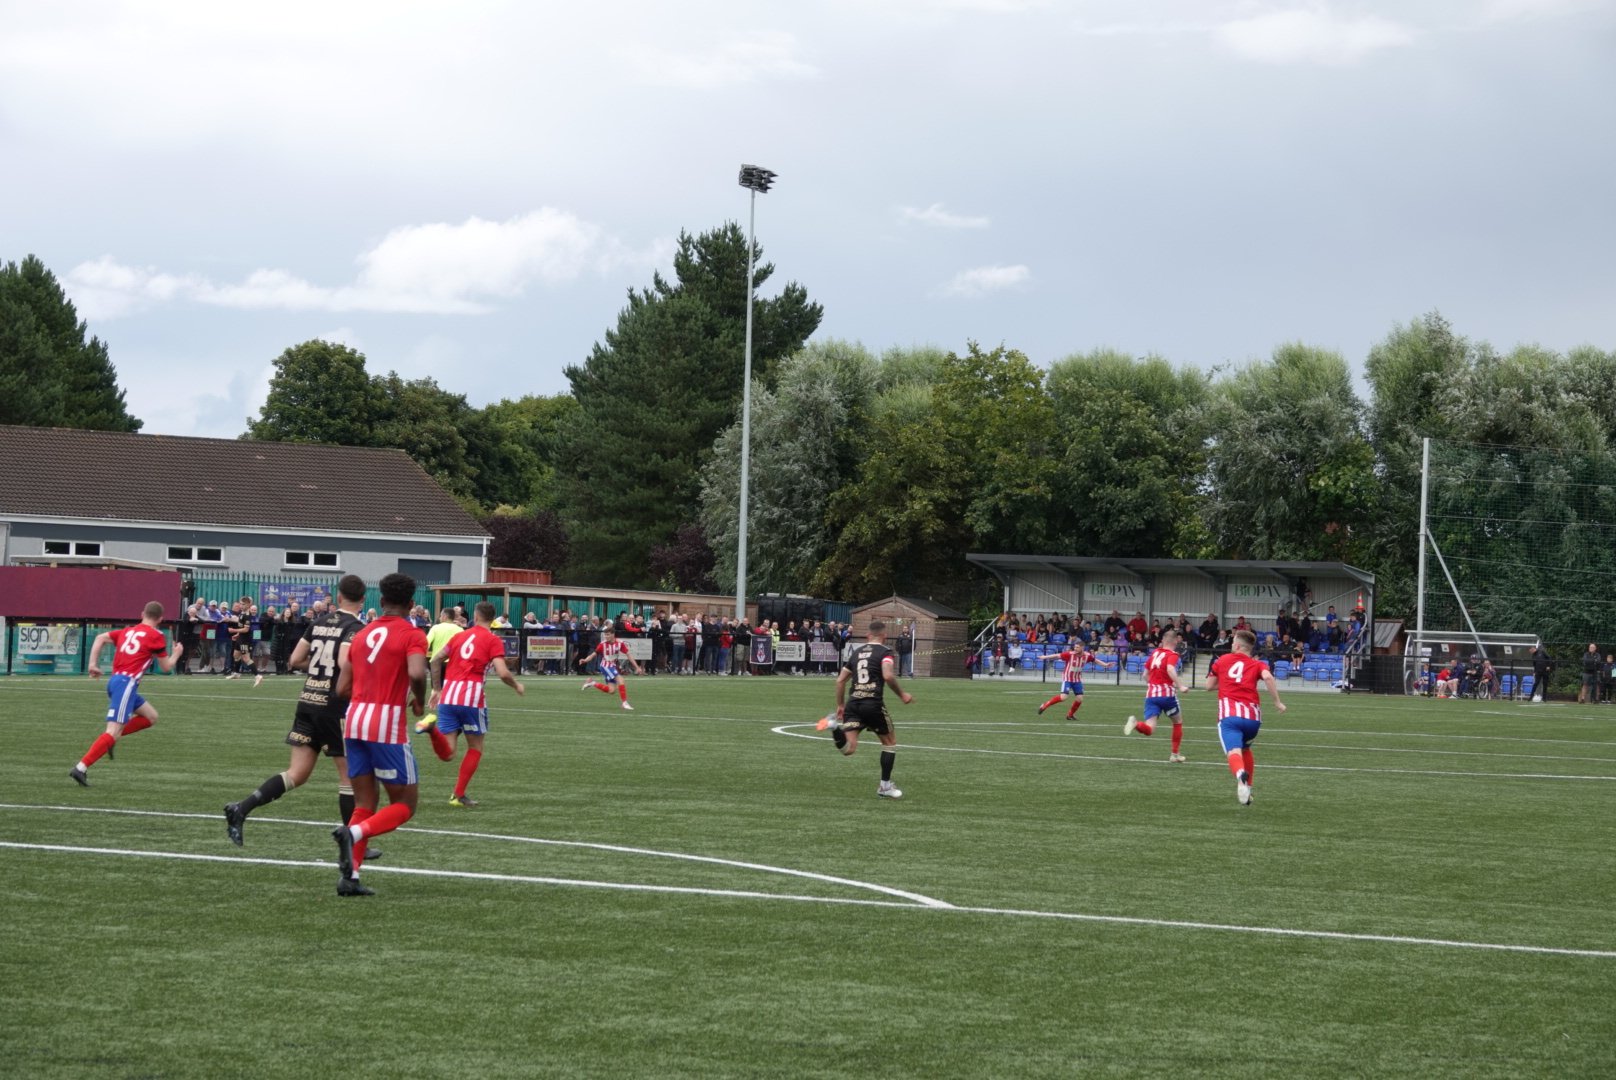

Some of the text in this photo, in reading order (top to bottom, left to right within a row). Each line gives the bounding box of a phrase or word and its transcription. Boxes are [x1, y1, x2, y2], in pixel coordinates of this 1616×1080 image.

[20, 627, 49, 650] sign
[120, 630, 147, 655] 15
[366, 626, 388, 664] 9
[460, 634, 475, 659] 6
[308, 639, 335, 677] 24
[1151, 652, 1167, 670] 14
[857, 659, 870, 683] 6
[1228, 660, 1245, 683] 4
